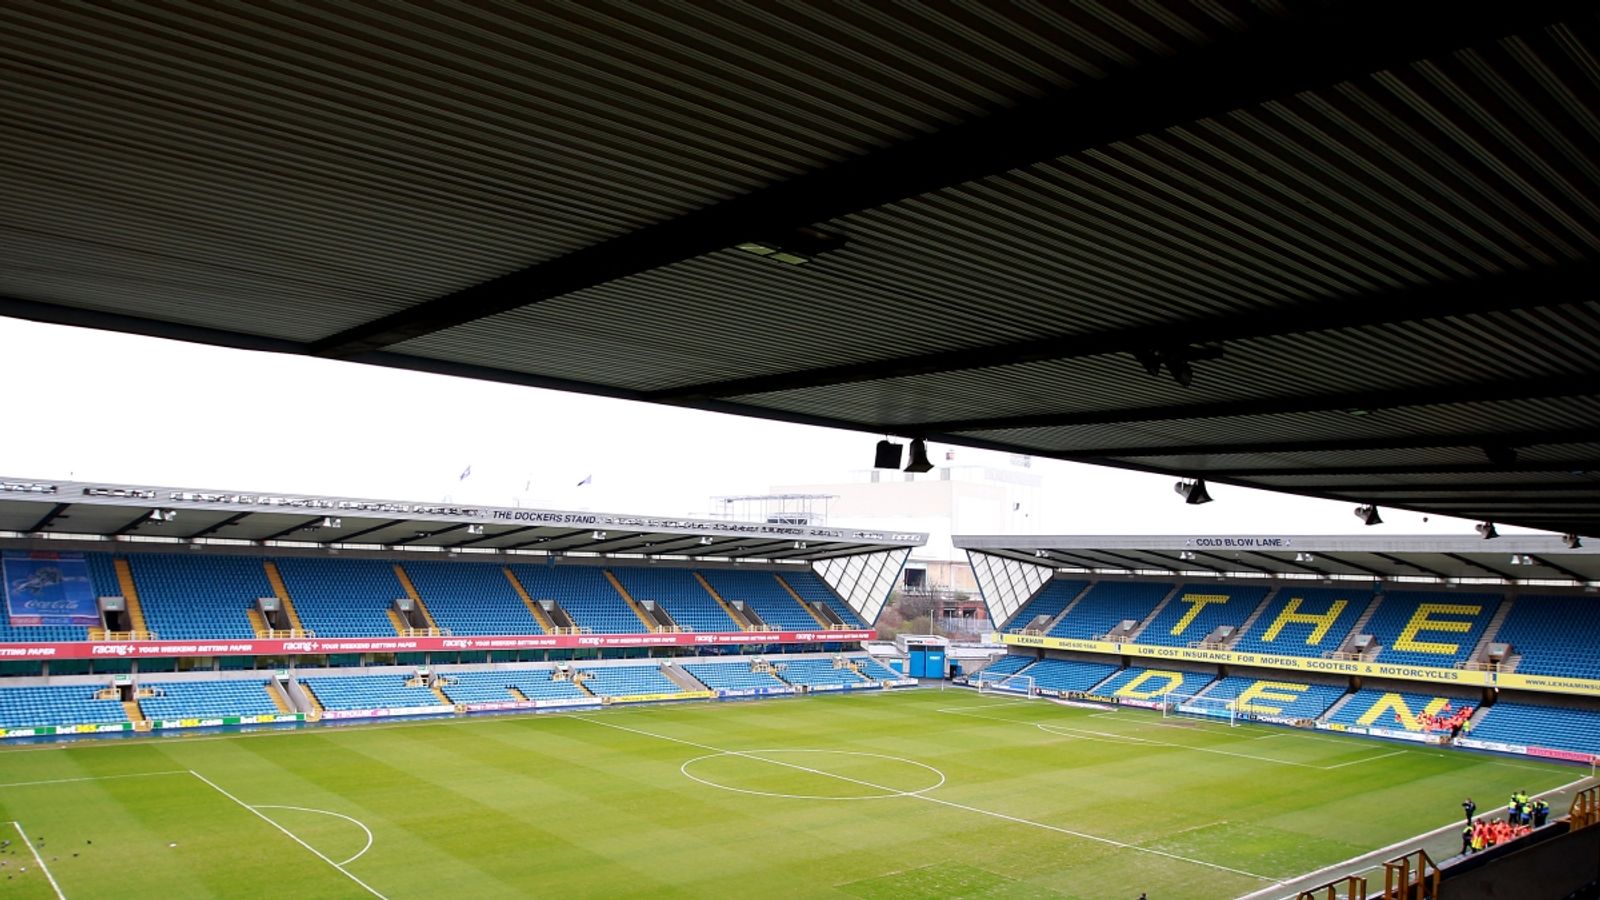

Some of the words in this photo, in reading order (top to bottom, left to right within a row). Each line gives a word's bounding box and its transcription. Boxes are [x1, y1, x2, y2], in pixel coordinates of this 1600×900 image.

[493, 510, 512, 520] THE
[514, 511, 563, 523] DOCKERS
[564, 514, 596, 524] STAND
[1196, 538, 1222, 547] COLD
[1225, 538, 1253, 547] BLOW
[1256, 538, 1282, 547] LANE
[27, 647, 56, 656] PAPER
[92, 644, 135, 656] racing+
[139, 646, 160, 654] YOUR
[160, 645, 197, 653] WEEKEND
[229, 644, 253, 652] PAPER
[283, 641, 319, 652] racing+
[397, 641, 417, 649] PAPER
[1139, 647, 1155, 655] LOW
[1157, 648, 1179, 657] COST
[1183, 650, 1232, 661] INSURANCE
[1237, 655, 1255, 663] FOR
[1261, 657, 1300, 668] MOPEDS,
[1307, 660, 1358, 672] SCOOTERS
[1365, 665, 1372, 673] &
[1380, 667, 1458, 680] MOTORCYCLES
[162, 718, 223, 728] bet365.com
[240, 714, 297, 724] bet365.com
[56, 724, 123, 734] bet365.com
